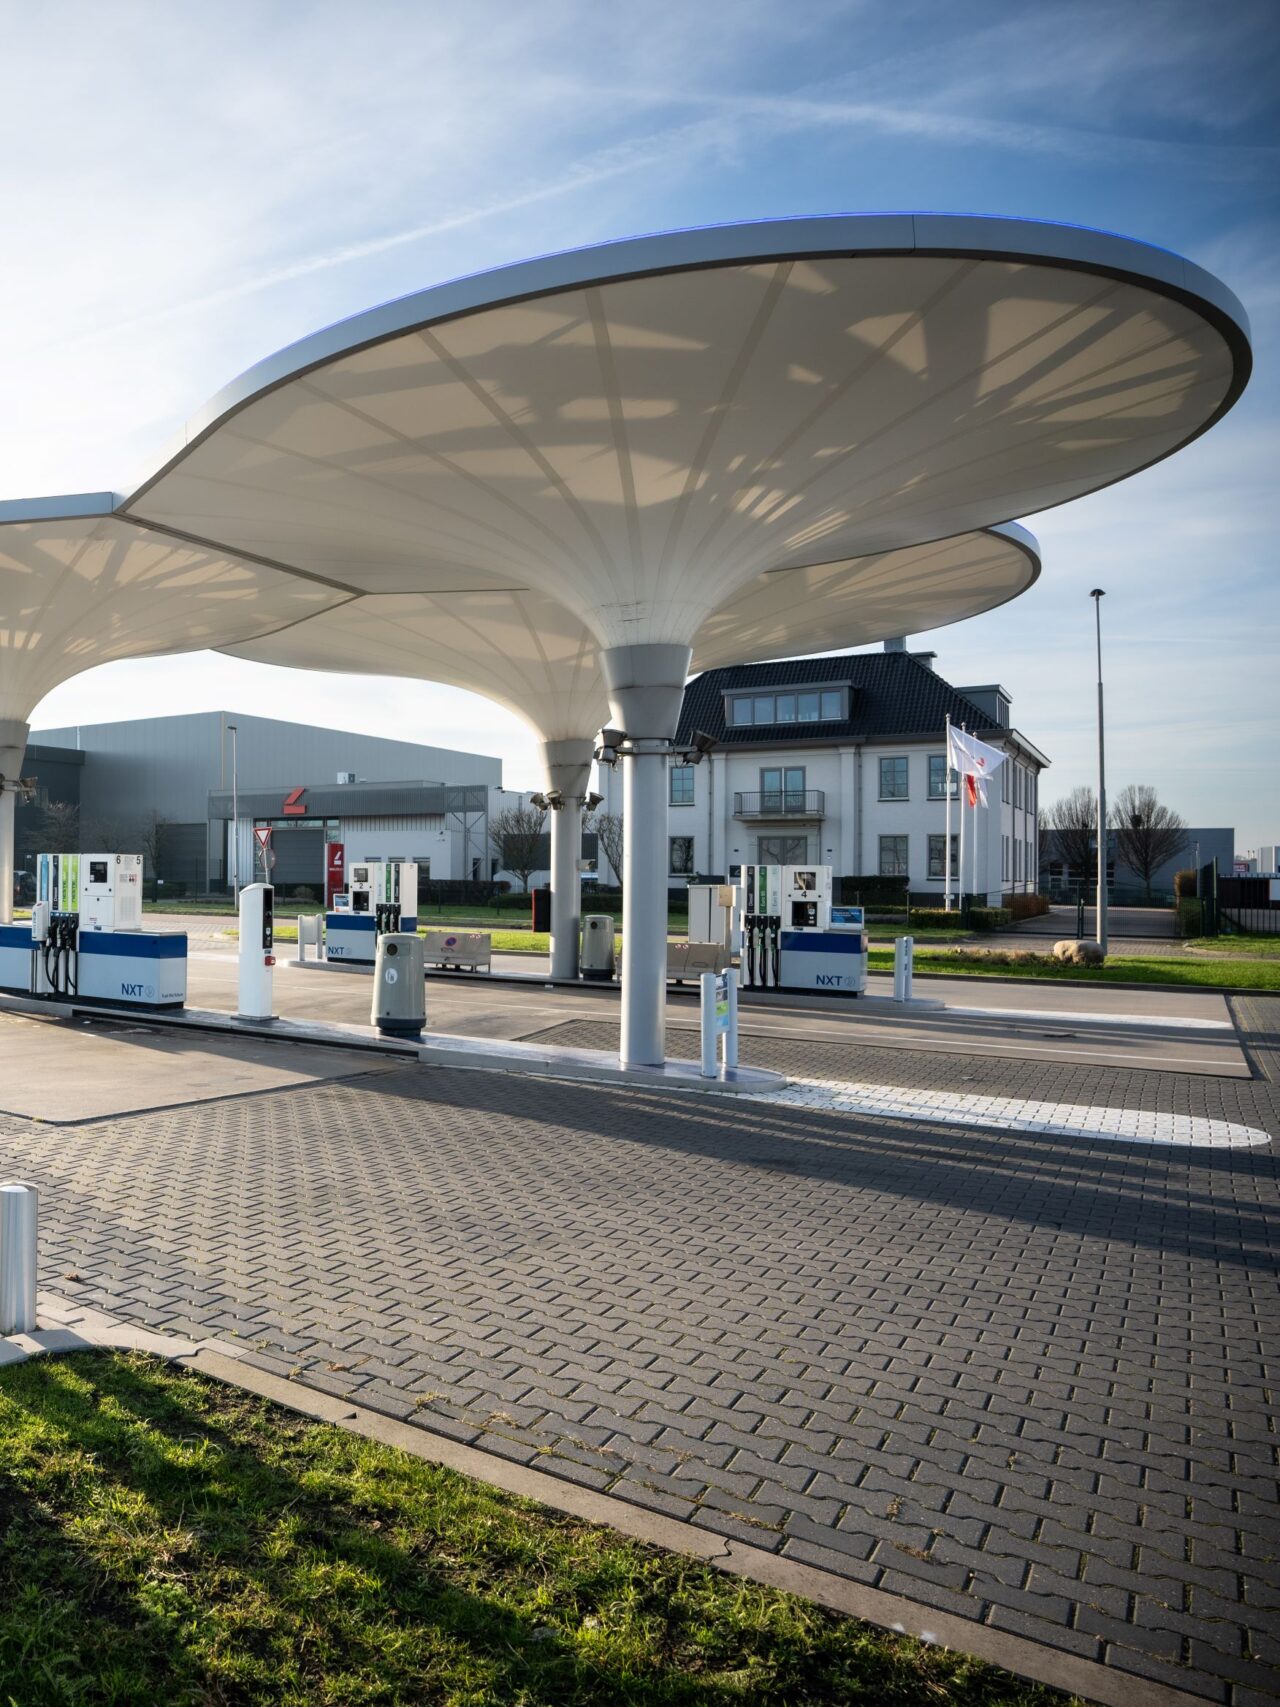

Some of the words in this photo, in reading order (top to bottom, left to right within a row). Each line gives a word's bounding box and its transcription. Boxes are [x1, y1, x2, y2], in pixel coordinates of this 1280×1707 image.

[115, 855, 122, 865] 6
[136, 855, 142, 865] 5
[359, 882, 364, 890] 2
[800, 890, 808, 899] 4
[327, 946, 345, 955] NXT
[816, 974, 843, 986] NXT
[121, 983, 144, 997] NXT
